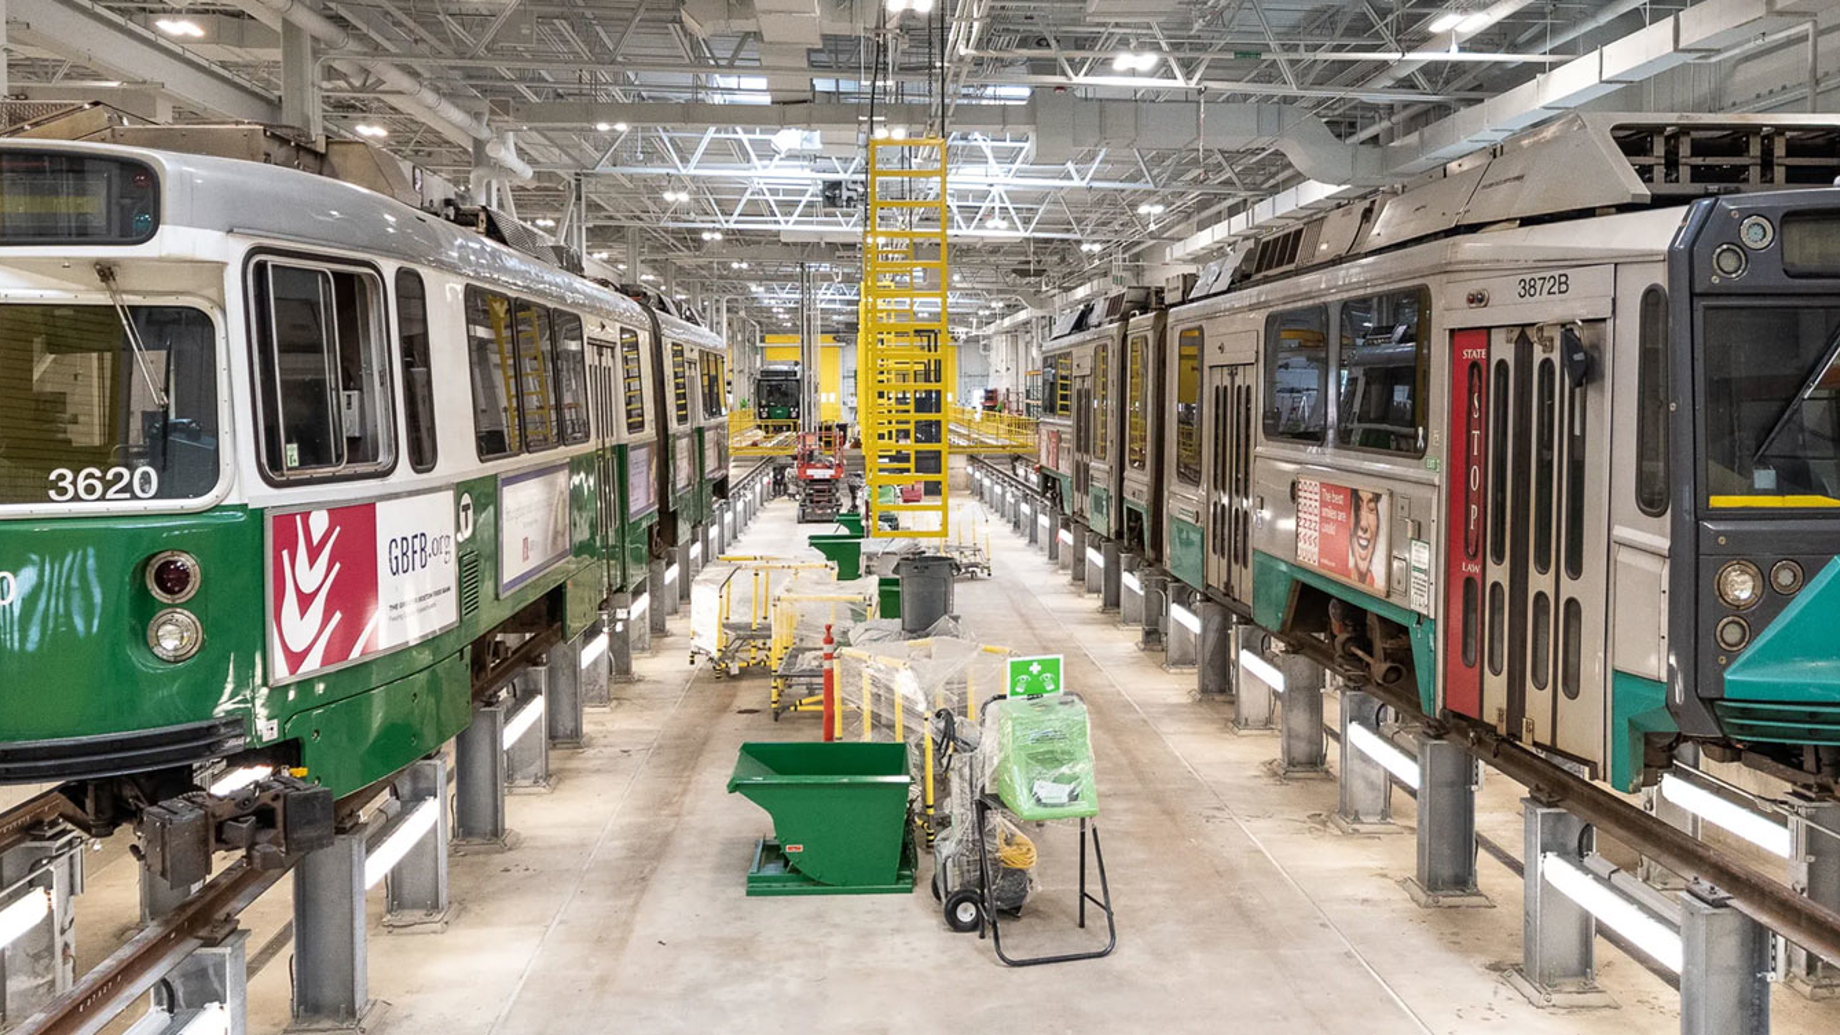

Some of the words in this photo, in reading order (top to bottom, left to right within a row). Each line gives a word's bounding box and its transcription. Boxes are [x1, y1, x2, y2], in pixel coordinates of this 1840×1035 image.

[1518, 273, 1570, 299] 3872B
[1462, 348, 1487, 360] STATE
[1470, 392, 1481, 530] STOP
[48, 465, 159, 501] 3620
[1321, 487, 1331, 503] The
[388, 532, 451, 576] GBFB.org
[1462, 562, 1481, 574] LAW
